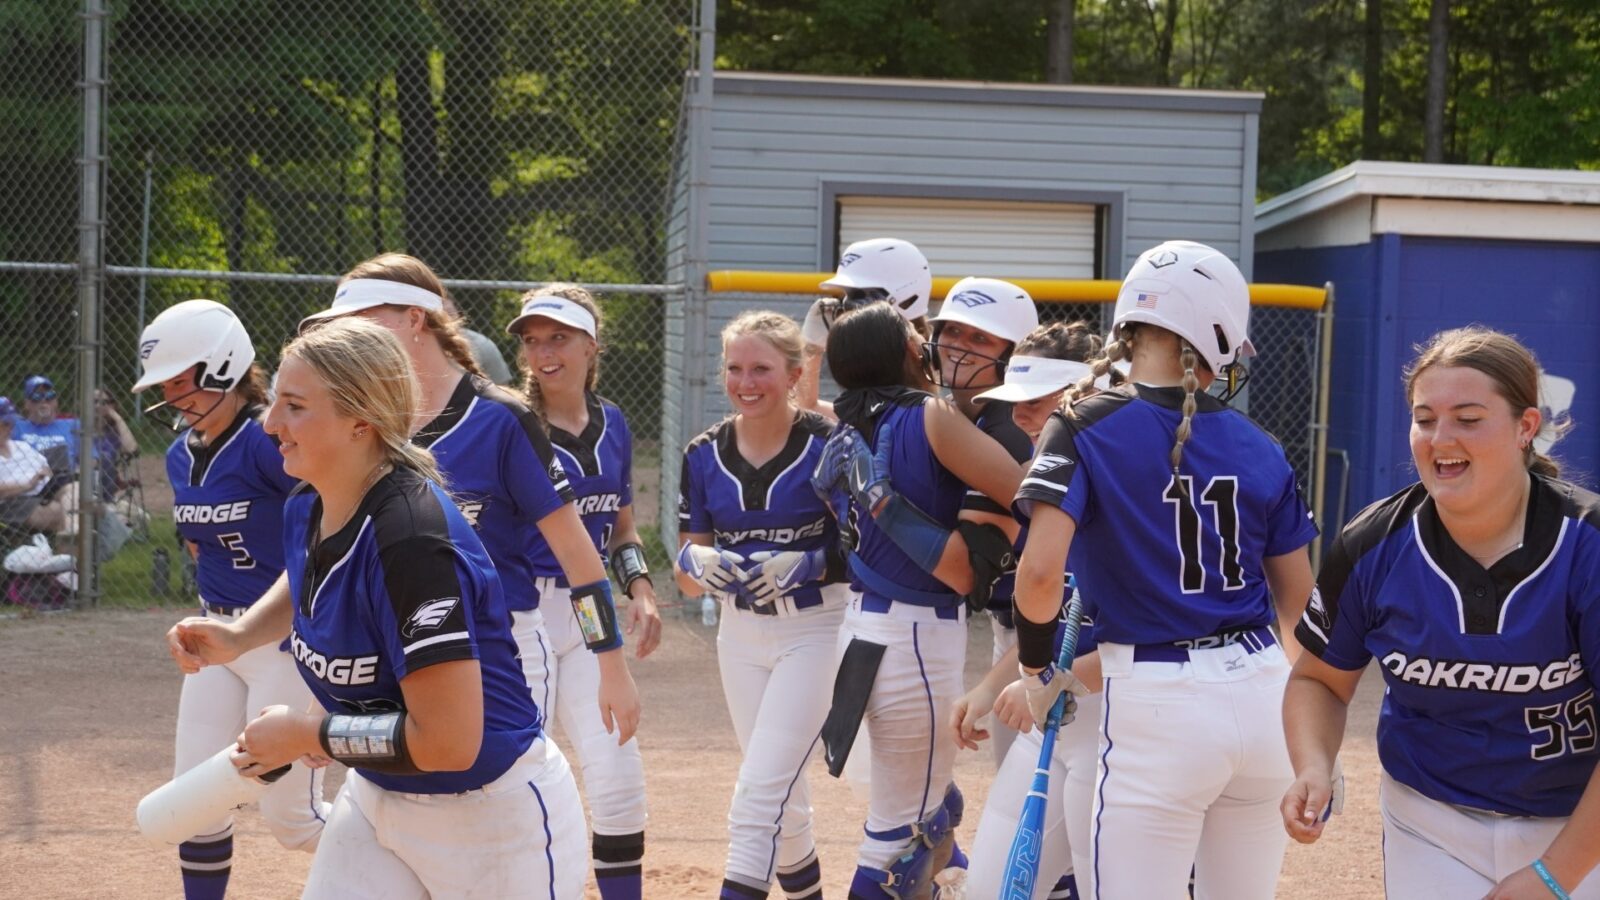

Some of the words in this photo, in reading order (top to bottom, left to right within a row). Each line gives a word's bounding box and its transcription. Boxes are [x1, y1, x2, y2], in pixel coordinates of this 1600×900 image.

[217, 532, 256, 569] 5
[1162, 475, 1246, 594] 11
[1382, 651, 1585, 693] OAKRIDGE
[1524, 688, 1598, 761] 55
